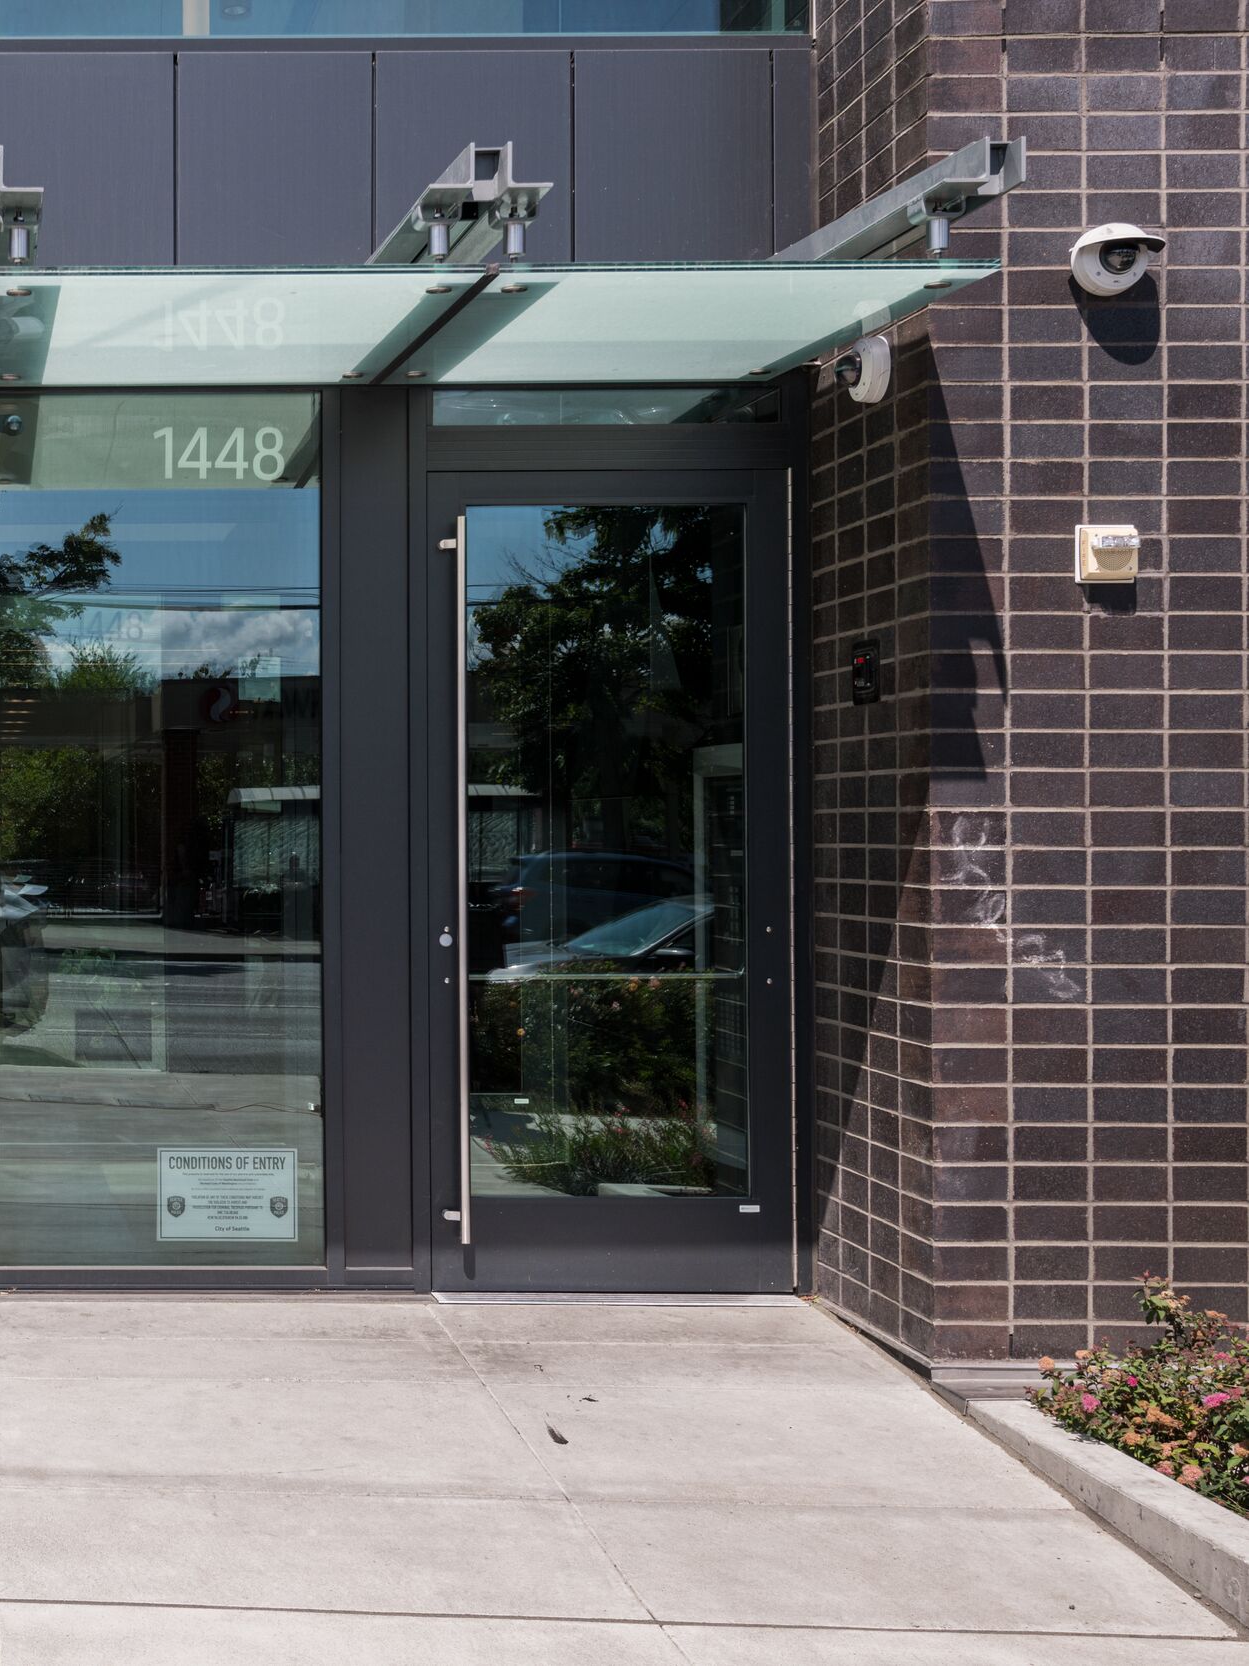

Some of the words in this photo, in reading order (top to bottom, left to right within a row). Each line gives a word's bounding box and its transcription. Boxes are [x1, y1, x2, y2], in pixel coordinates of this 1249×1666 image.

[153, 427, 285, 480] 1448
[168, 1156, 233, 1170] CONDITIONS
[236, 1156, 250, 1170] OF
[253, 1156, 286, 1170] ENTRY
